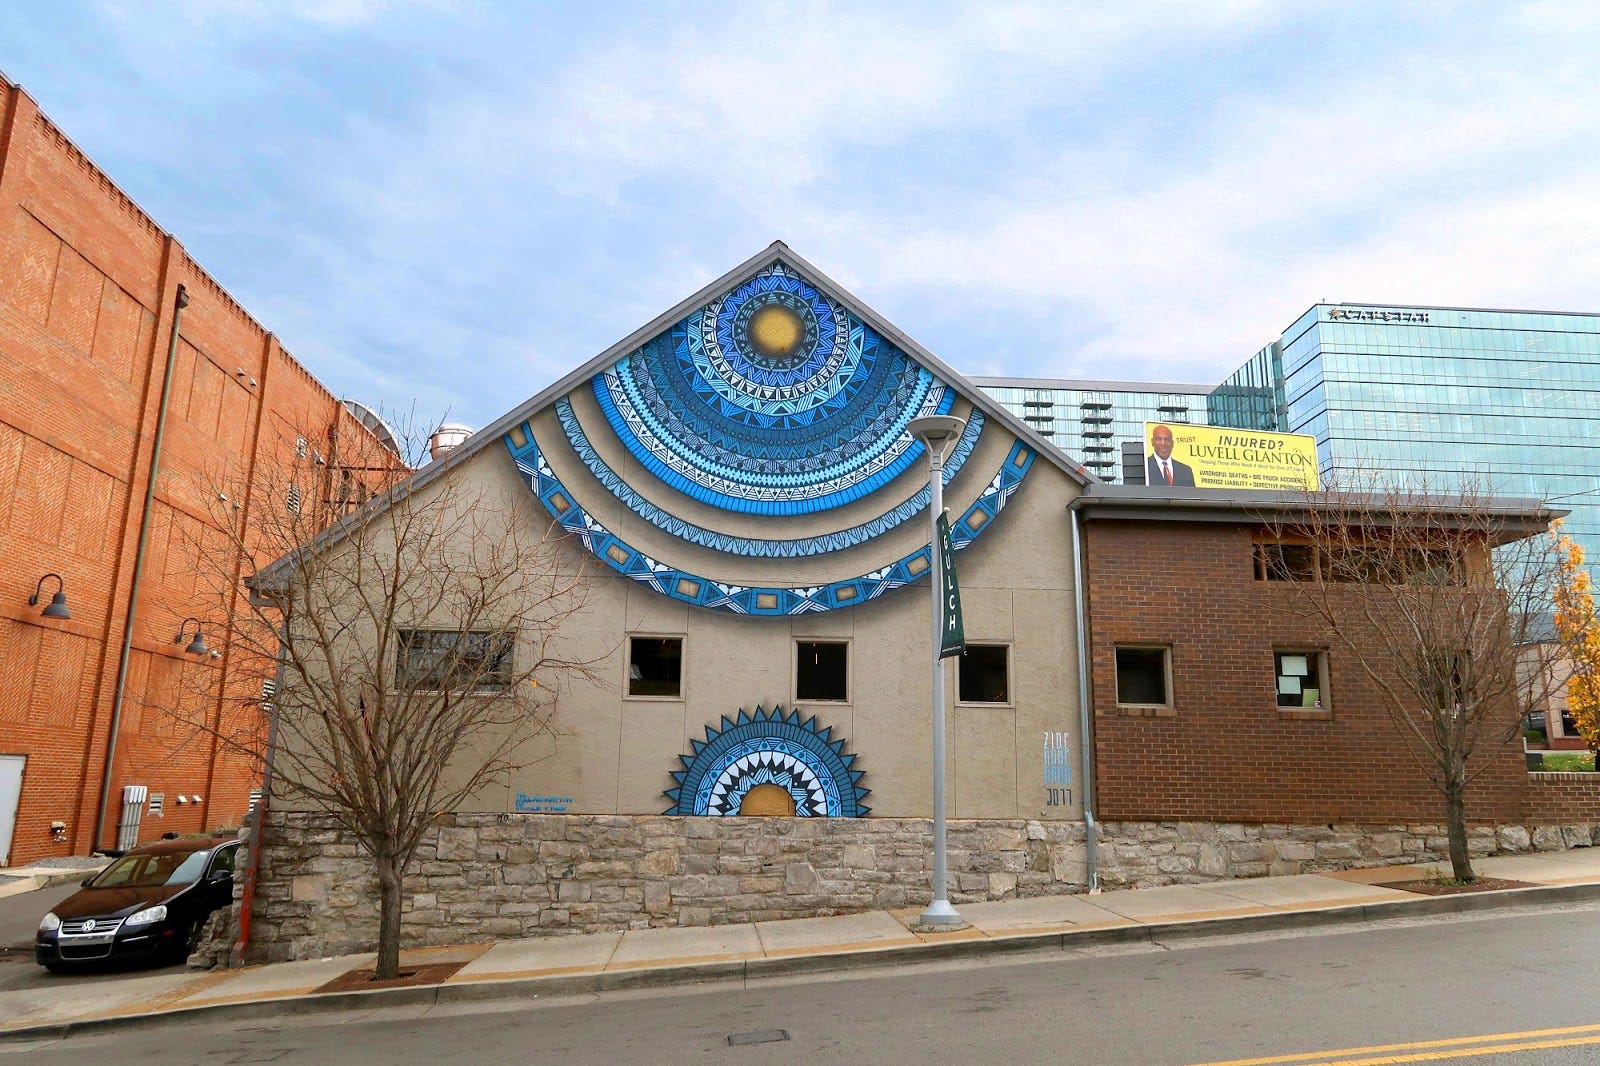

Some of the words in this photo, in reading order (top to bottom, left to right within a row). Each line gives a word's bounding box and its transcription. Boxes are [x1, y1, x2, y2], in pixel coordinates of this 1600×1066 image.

[1345, 309, 1430, 323] CAPSTAR
[1176, 436, 1196, 444] TRUST
[1218, 435, 1284, 450] INJURED?
[1189, 444, 1240, 461] LUVELL
[1242, 448, 1312, 466] GLANTON
[1201, 477, 1224, 485] PREMISE
[1224, 479, 1249, 487] LIABILITY
[1229, 471, 1248, 479] DEATHS
[943, 534, 956, 631] GULCH
[1046, 788, 1072, 806] 2017
